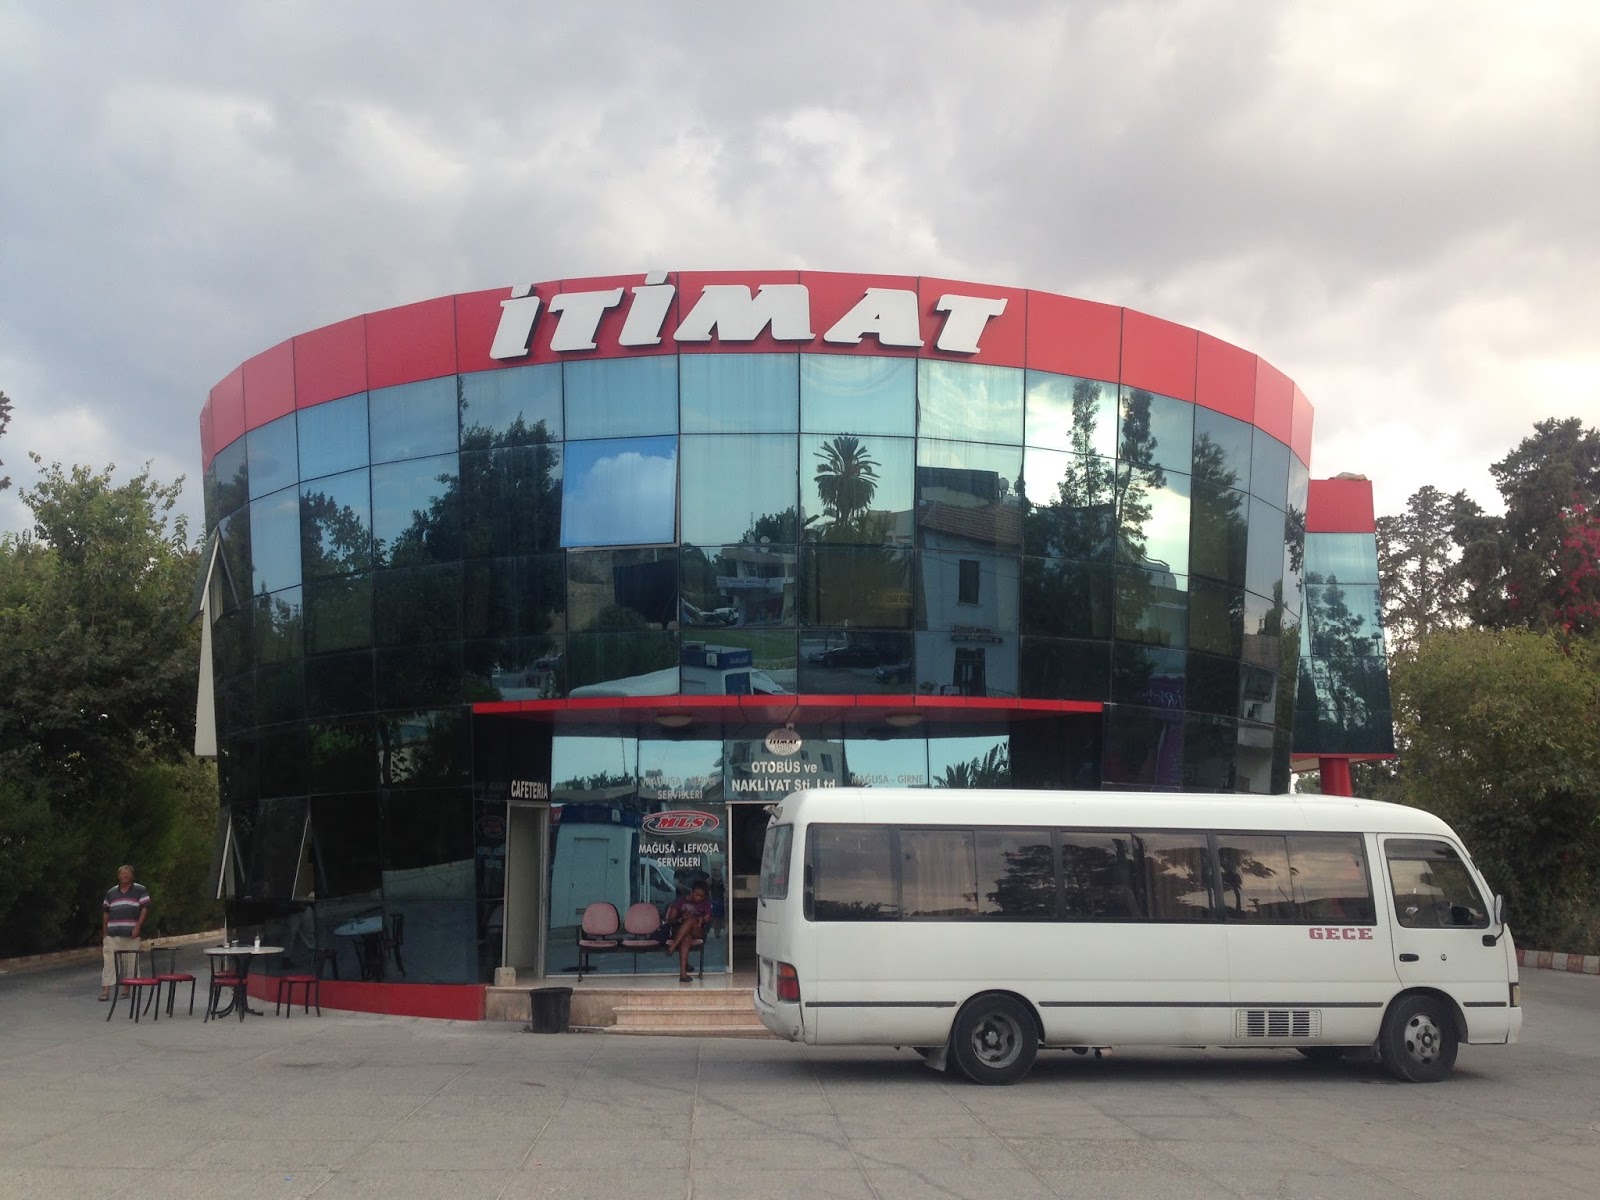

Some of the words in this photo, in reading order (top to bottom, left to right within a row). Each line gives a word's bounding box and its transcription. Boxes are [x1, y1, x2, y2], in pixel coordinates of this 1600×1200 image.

[751, 759, 801, 774] OTOBÜS
[803, 763, 818, 774] ve
[731, 776, 791, 792] NAKLİYAT
[897, 772, 924, 784] GİRNE
[511, 779, 549, 800] CAFETERIA
[656, 816, 707, 829] MLS
[638, 841, 676, 854] MAĞUSA
[683, 843, 720, 856] LEFKOŞA
[657, 855, 702, 868] SERVİSLERİ
[1308, 927, 1374, 940] GECE
